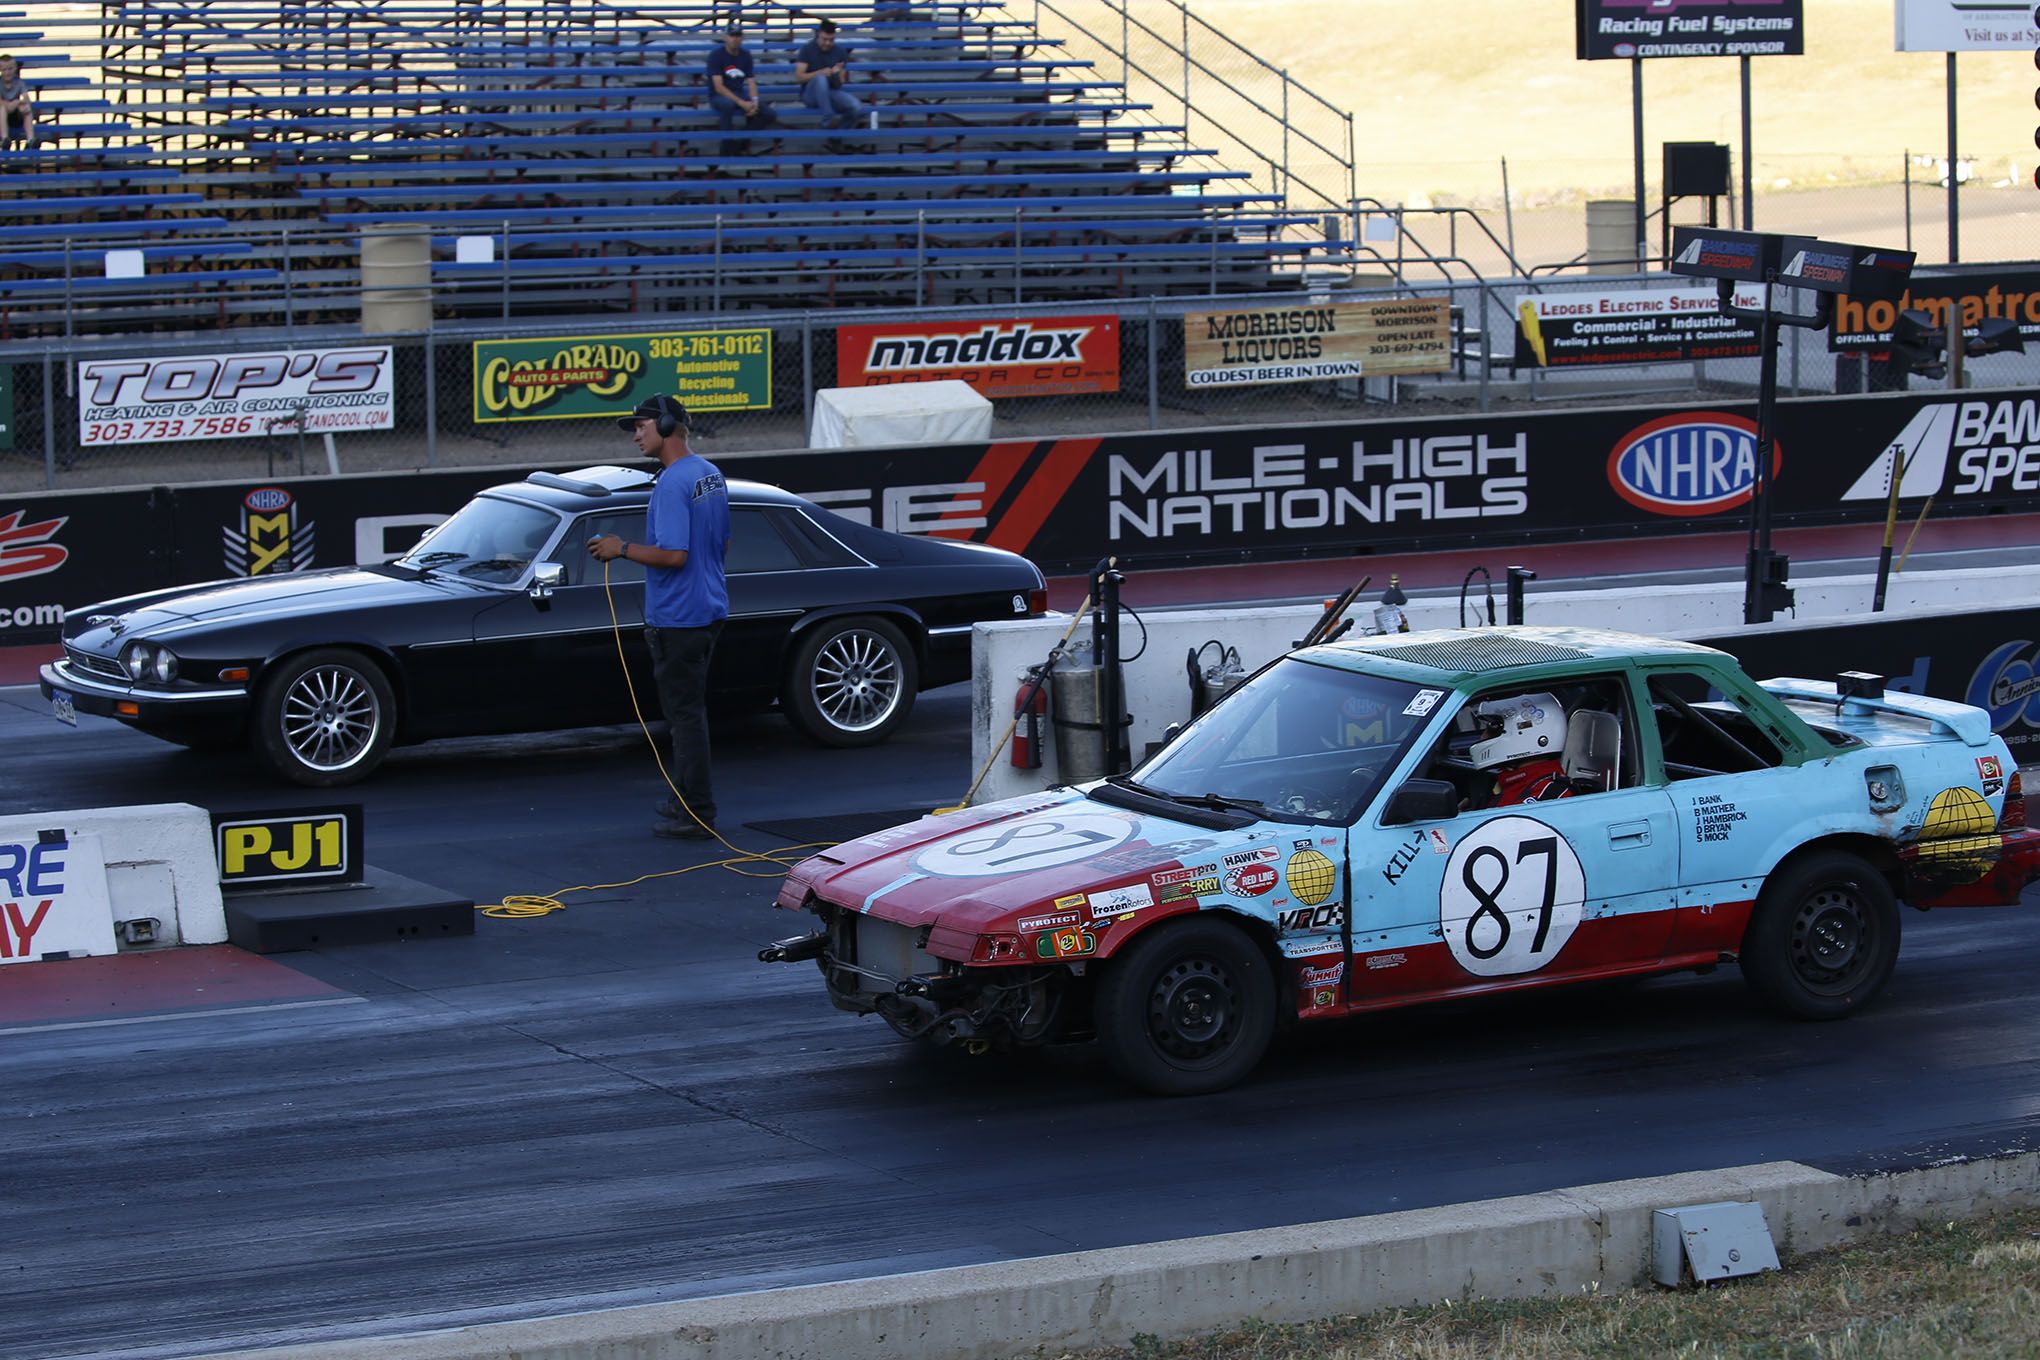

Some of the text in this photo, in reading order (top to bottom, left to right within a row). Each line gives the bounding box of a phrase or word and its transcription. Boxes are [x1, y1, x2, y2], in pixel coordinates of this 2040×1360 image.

[1599, 15, 1793, 36] Racing Fuel Systems
[1965, 28, 1992, 41] Visit
[1996, 31, 2008, 41] us
[2012, 31, 2023, 41] at
[1637, 43, 1722, 56] CONTINGENCY
[1726, 41, 1784, 54] SPONSOR
[1207, 309, 1335, 339] MORRISON
[1375, 316, 1438, 327] MORRISON
[1573, 319, 1656, 334] Commercial
[1671, 314, 1736, 329] Industrial
[1378, 330, 1435, 342] OPEN LATE
[1553, 337, 1588, 347] Fueling
[1603, 334, 1637, 344] Control
[1648, 332, 1682, 343] Service
[1696, 329, 1754, 340] Construction
[1836, 335, 1877, 344] OFFICIAL
[649, 335, 763, 358] 303-761-0112
[1222, 335, 1322, 364] LIQUORS
[676, 361, 740, 373] Automotive
[1190, 362, 1360, 385] COLDEST BEER IN TOWN
[85, 350, 387, 406] TOP'S
[513, 370, 604, 383] AUTO & PARTS
[679, 377, 735, 390] Recycling
[85, 393, 388, 421] HEATING & AIR CONDITIONING
[85, 416, 252, 442] 303.733.7586
[1635, 430, 1755, 497] NHRA
[251, 491, 287, 509] NHRA
[1109, 476, 1528, 540] NATIONALS
[1698, 795, 1722, 805] BANK
[1694, 803, 1735, 816] B MATHER
[1703, 812, 1747, 824] HAMBRICK
[1704, 823, 1732, 833] BRYAN
[1704, 832, 1729, 842] MOCK
[225, 821, 340, 873] PJ1
[1224, 850, 1260, 867] HAWK
[1382, 843, 1421, 886] KILL
[1242, 870, 1275, 886] RED LINE
[1463, 837, 1558, 960] 87
[1021, 915, 1078, 929] PYROTECT
[1290, 943, 1342, 955] TRANSPORTERS
